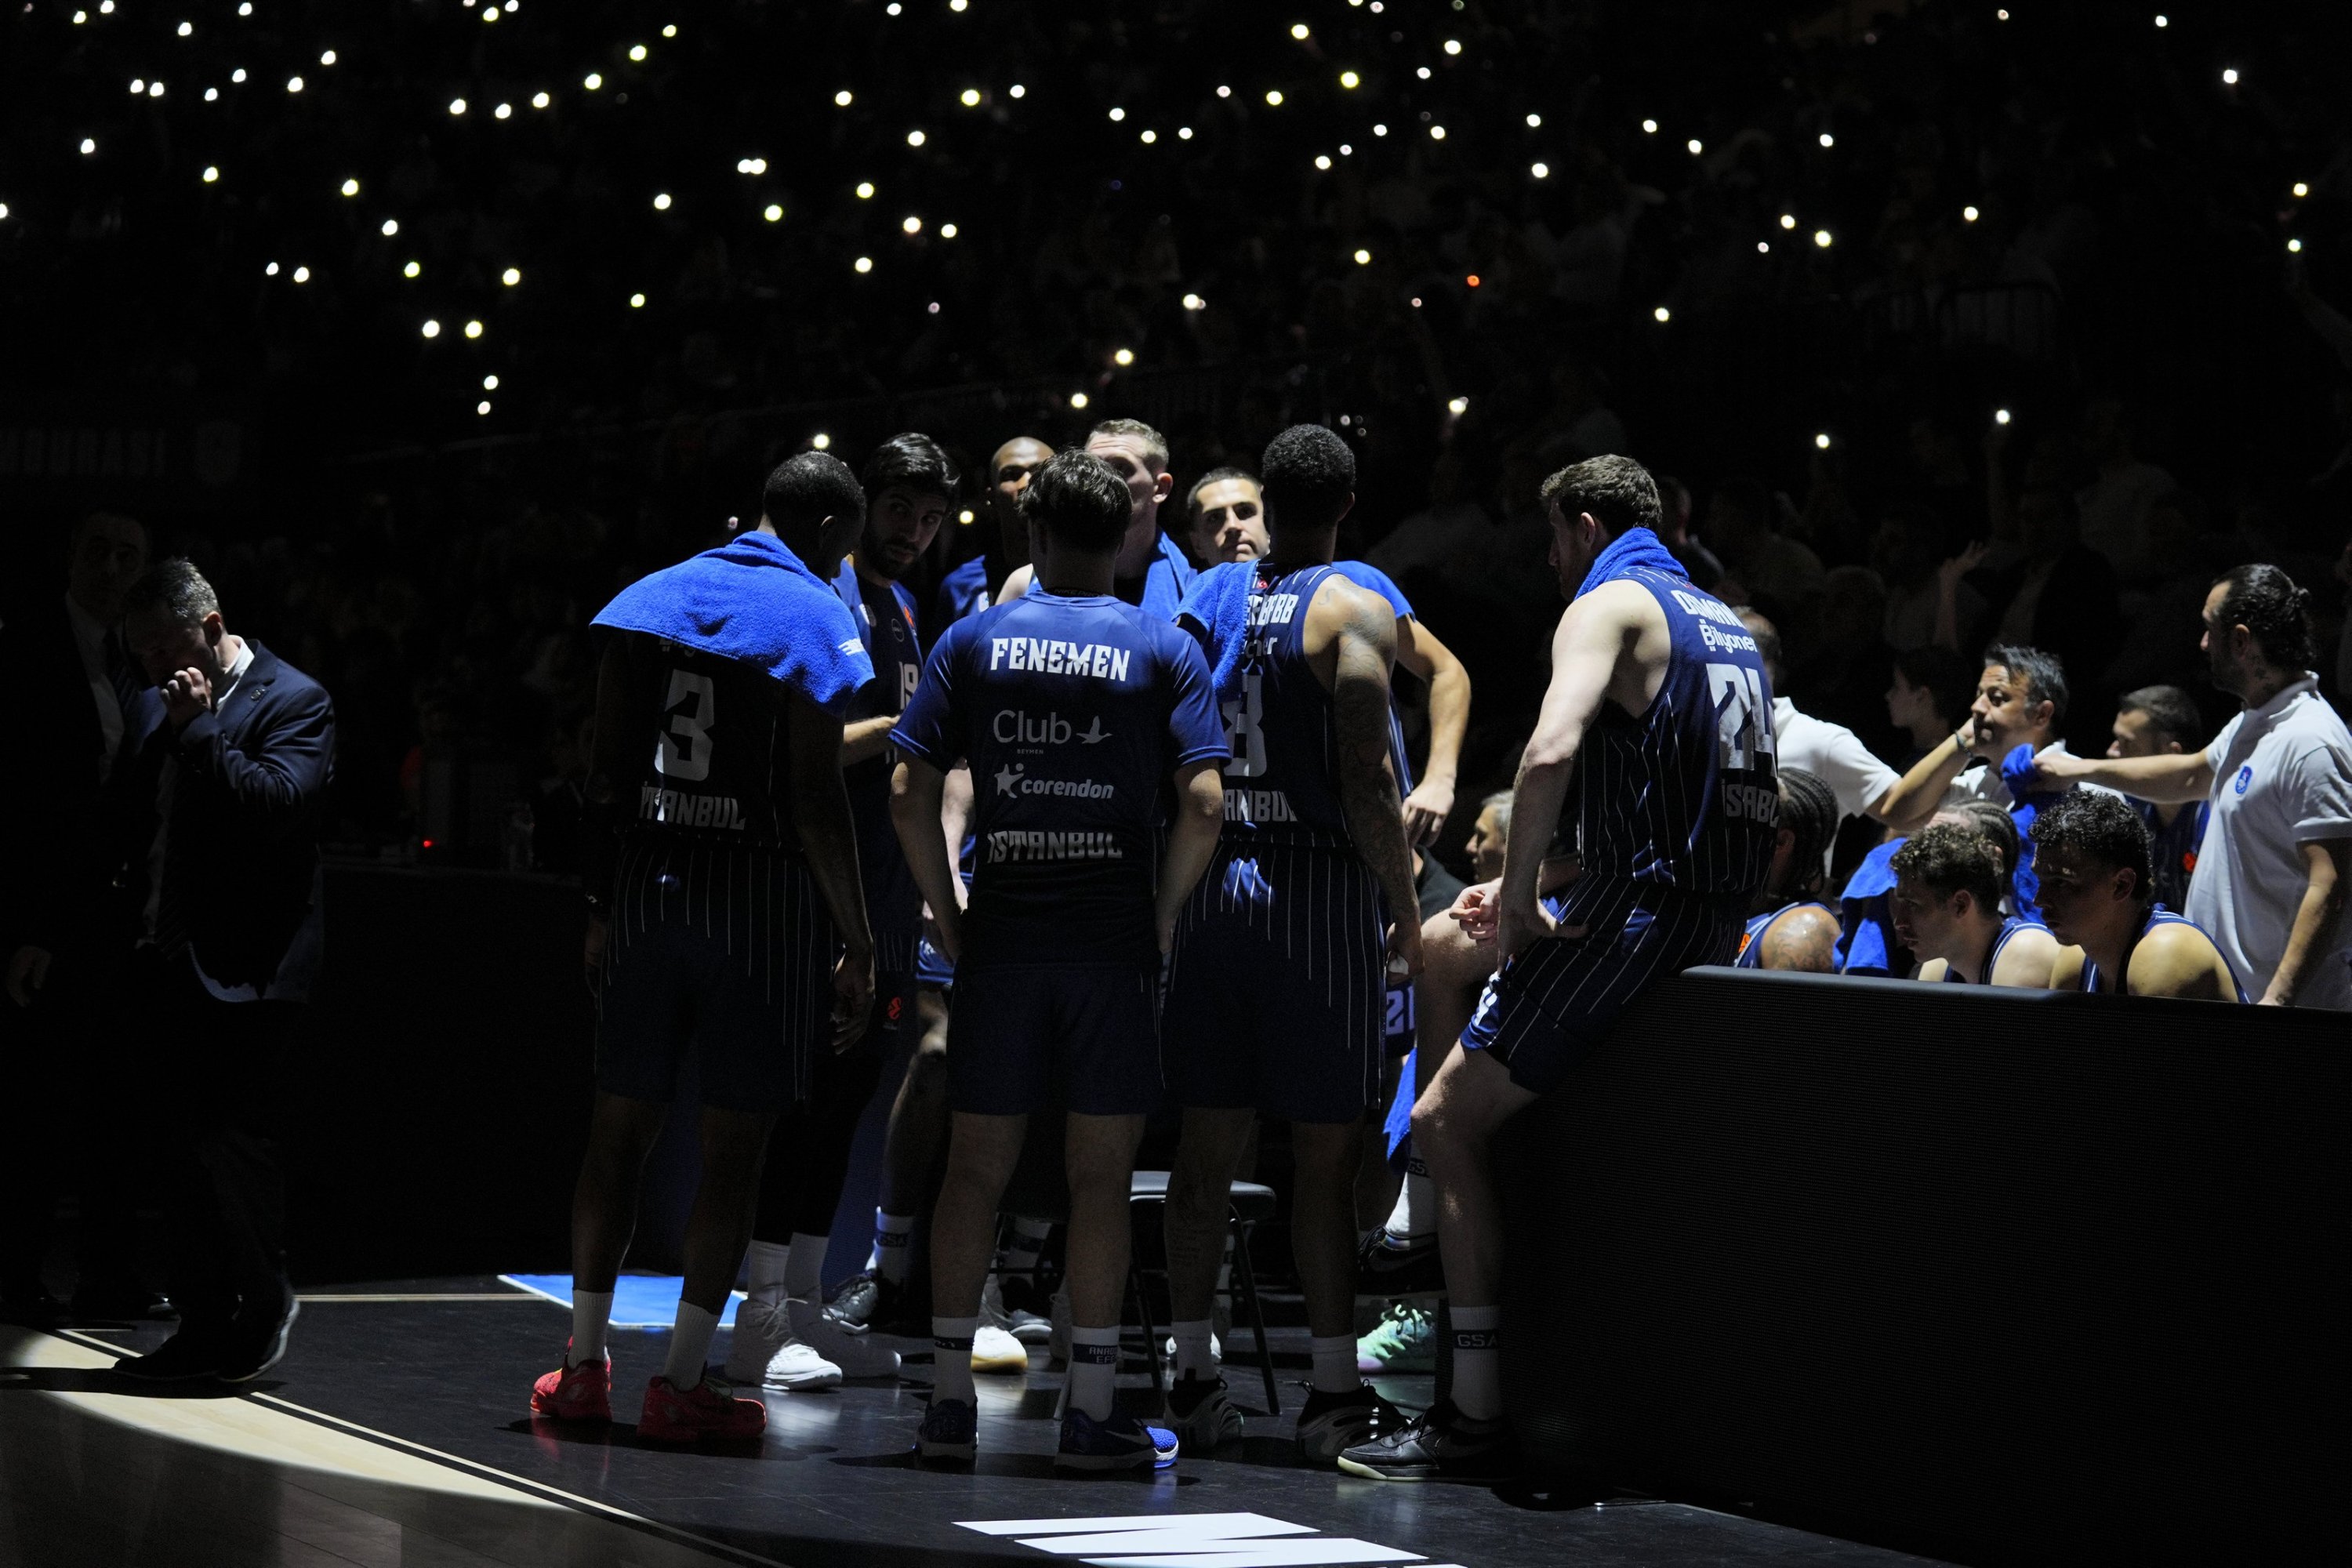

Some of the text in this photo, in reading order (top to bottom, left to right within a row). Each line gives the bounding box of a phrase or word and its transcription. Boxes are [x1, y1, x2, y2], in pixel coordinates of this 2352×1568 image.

[990, 637, 1131, 682] FENEMEN
[654, 668, 715, 782] 3
[993, 710, 1072, 744] Club
[1706, 662, 1779, 779] 24
[1021, 779, 1115, 799] corendon
[1386, 985, 1415, 1035] 21
